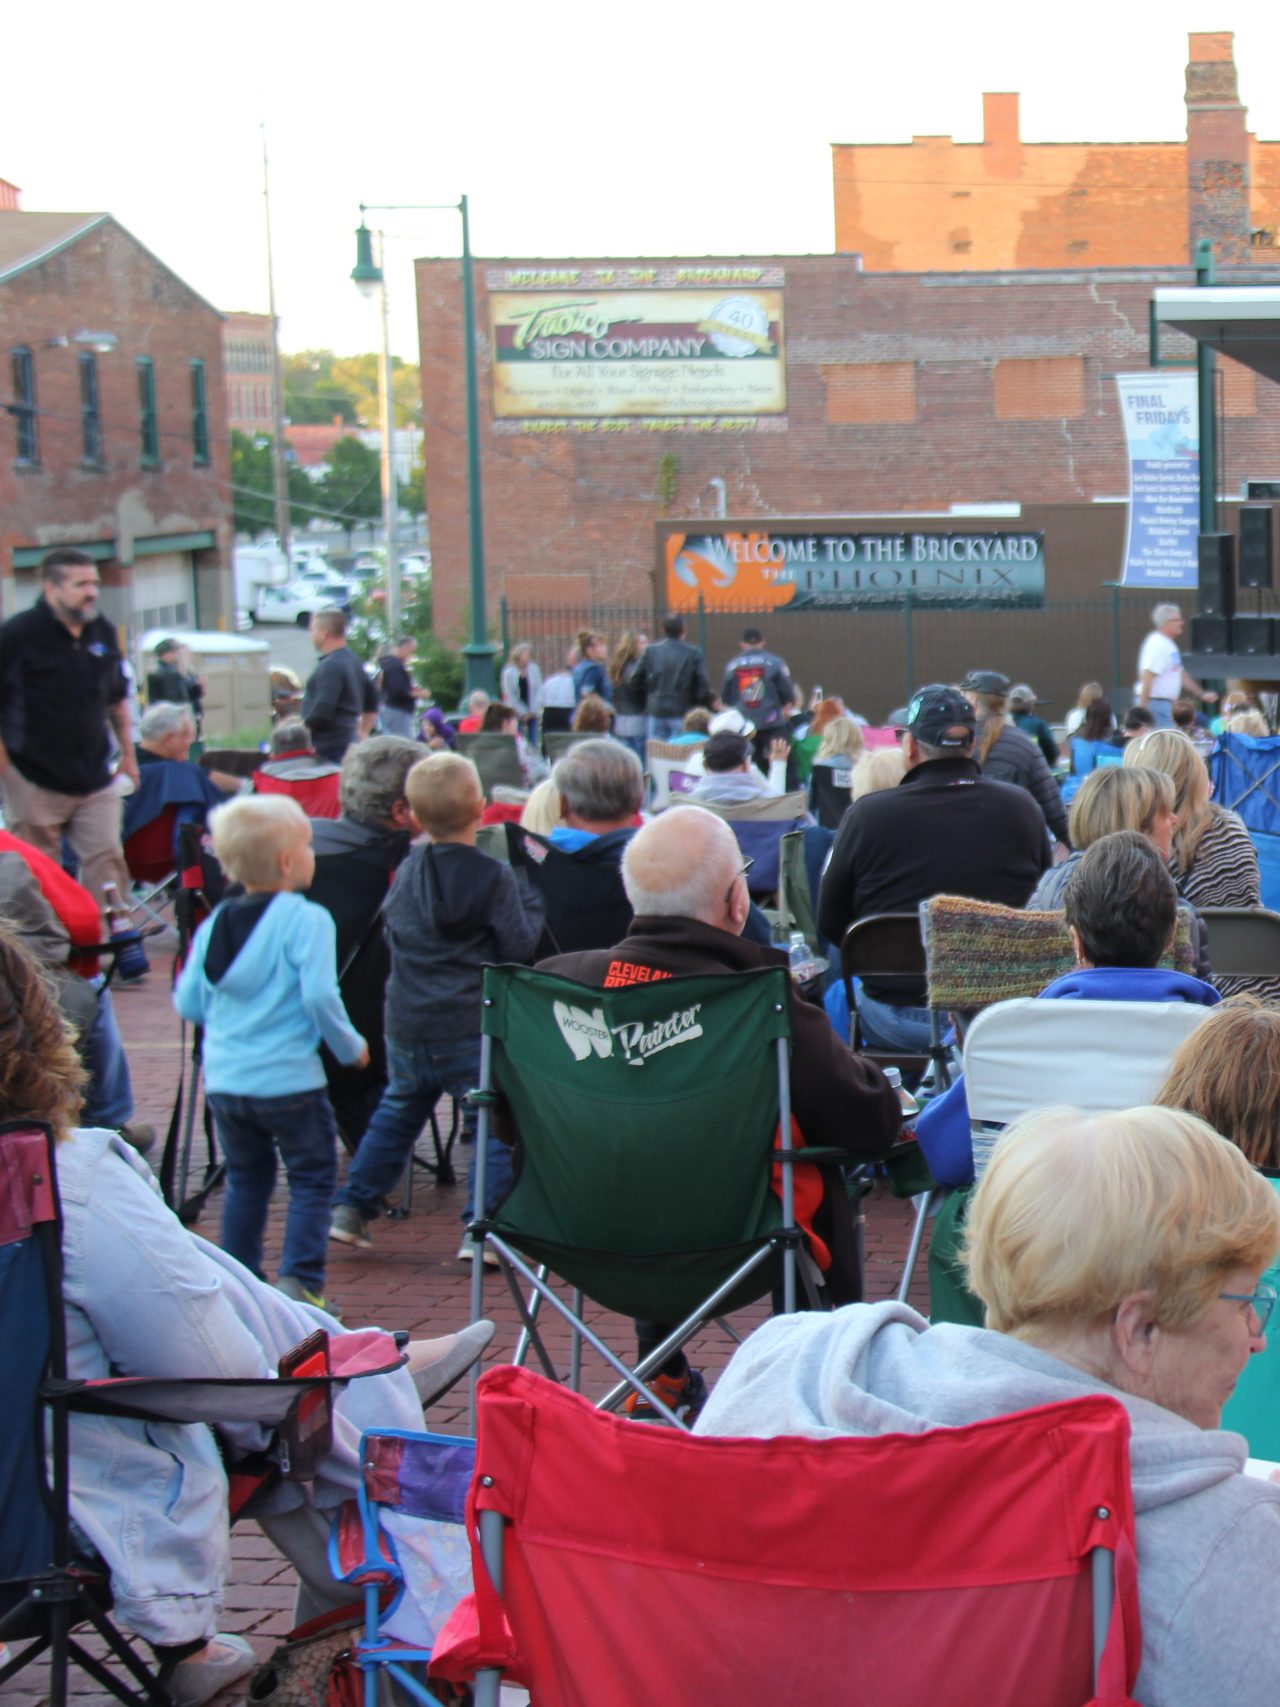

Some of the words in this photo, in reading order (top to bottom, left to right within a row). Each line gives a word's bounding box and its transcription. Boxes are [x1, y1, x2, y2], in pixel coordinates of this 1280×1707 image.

[531, 337, 586, 359] SIGN
[588, 336, 705, 358] COMPANY
[1127, 394, 1167, 409] FINAL
[1136, 410, 1192, 425] FRIDAYS
[704, 536, 818, 563] WELCOME
[824, 539, 856, 563] TO
[861, 538, 906, 562] THE
[912, 535, 1038, 562] BRICKYARD
[760, 568, 796, 580] THE
[805, 568, 1014, 591] PHOENIX
[608, 960, 673, 981] CLEVELA
[561, 1014, 610, 1041] WOOSTER
[611, 1003, 703, 1060] Painter
